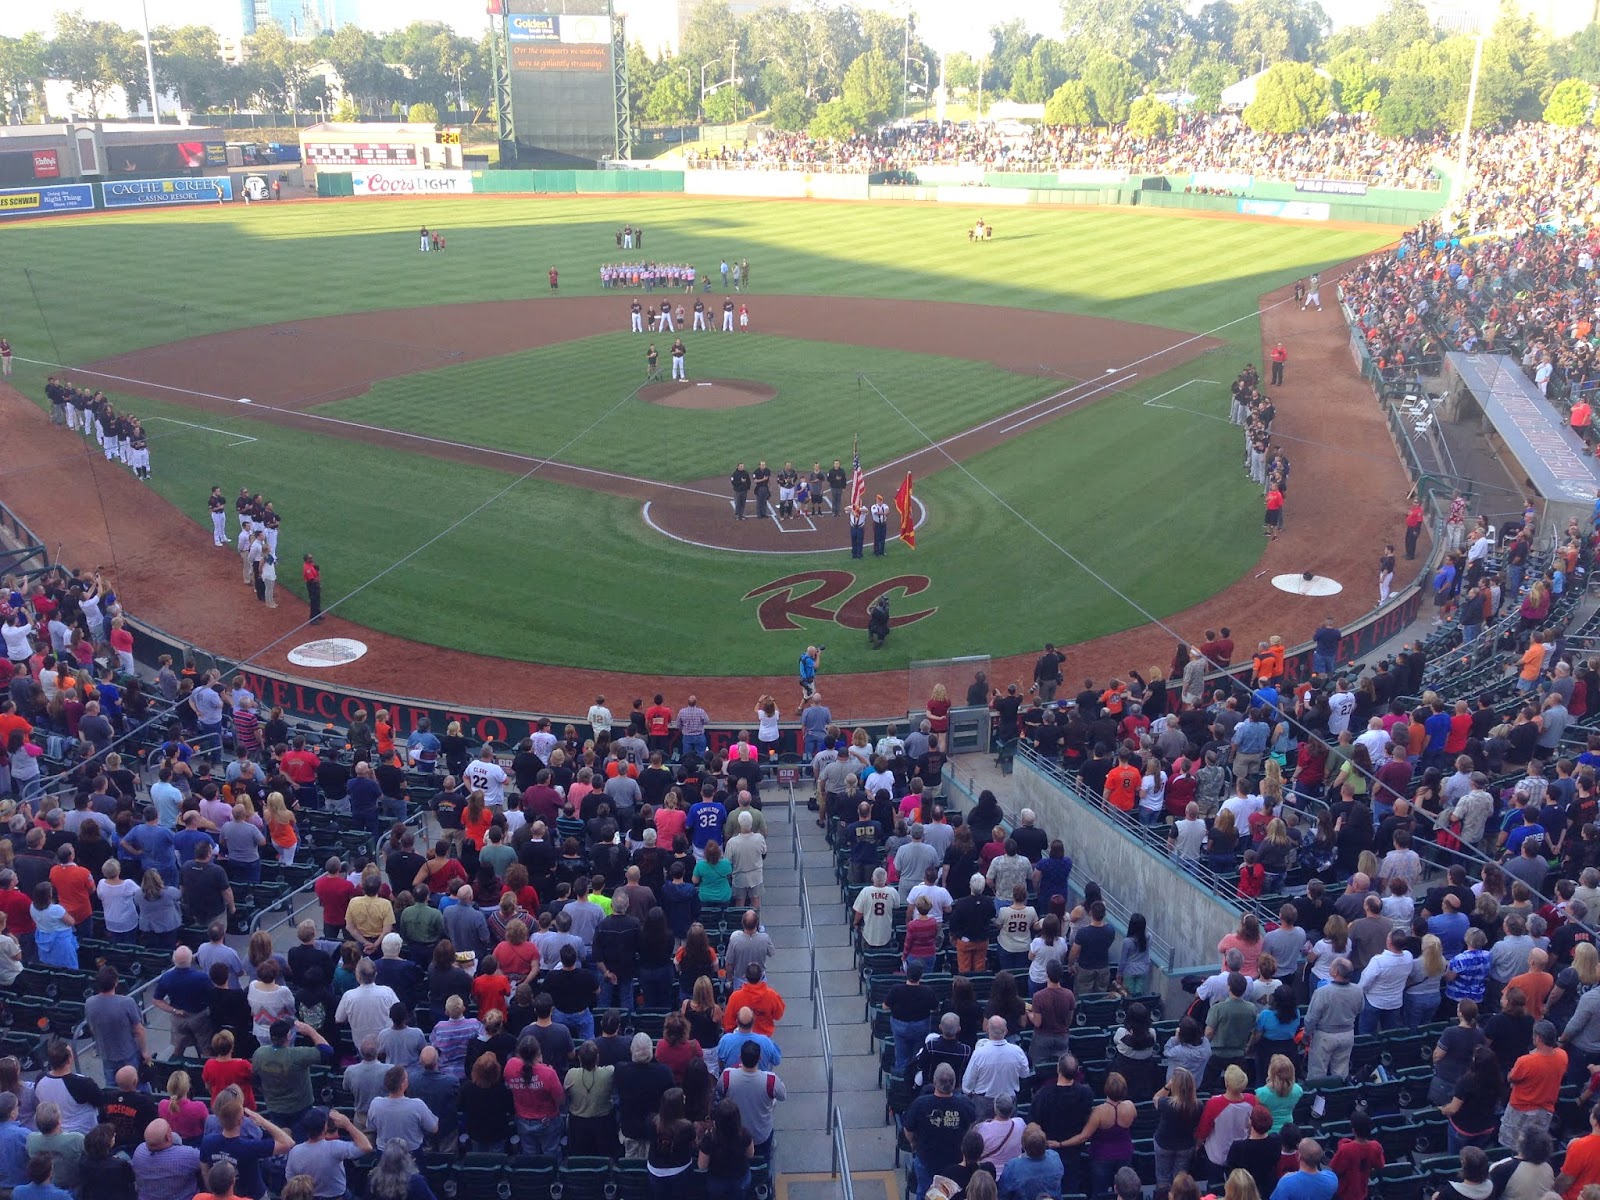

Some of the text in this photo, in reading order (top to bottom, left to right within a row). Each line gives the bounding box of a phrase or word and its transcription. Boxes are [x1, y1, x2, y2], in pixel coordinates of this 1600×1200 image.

[513, 17, 547, 29] Golden
[514, 46, 526, 54] Over
[528, 46, 538, 54] the
[112, 179, 221, 195] CACHE CREEK
[367, 173, 457, 192] Coors LIGHT
[0, 196, 38, 206] ES SCHWAB
[43, 195, 82, 204] Right Thing
[138, 192, 198, 203] CASINO RESORT
[1340, 703, 1353, 716] 27
[472, 774, 489, 790] 22
[1122, 778, 1131, 788] 8
[699, 814, 718, 828] 32
[871, 892, 889, 901] PENCE
[873, 902, 885, 916] 8
[1008, 921, 1028, 933] 28
